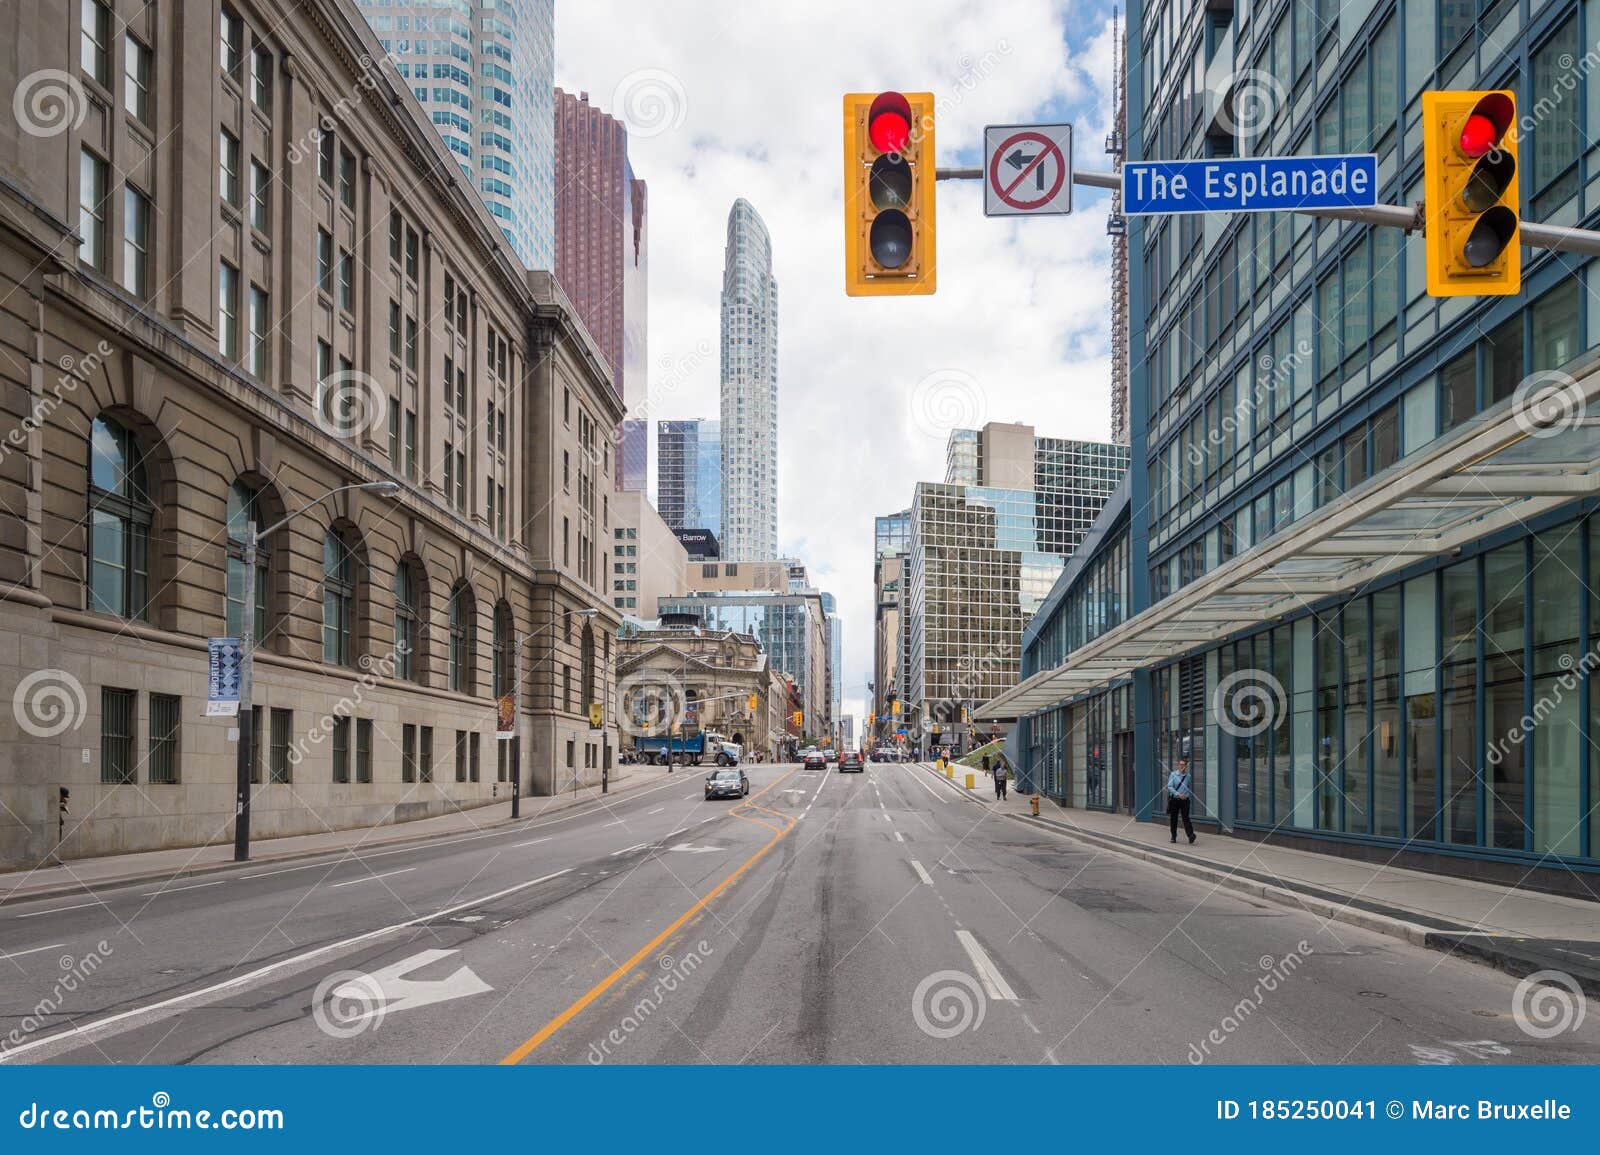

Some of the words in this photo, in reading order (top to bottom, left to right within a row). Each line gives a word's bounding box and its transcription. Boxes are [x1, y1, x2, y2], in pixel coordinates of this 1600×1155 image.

[1132, 167, 1188, 200] The
[1205, 161, 1368, 206] Esplanade
[682, 533, 707, 541] Barrow
